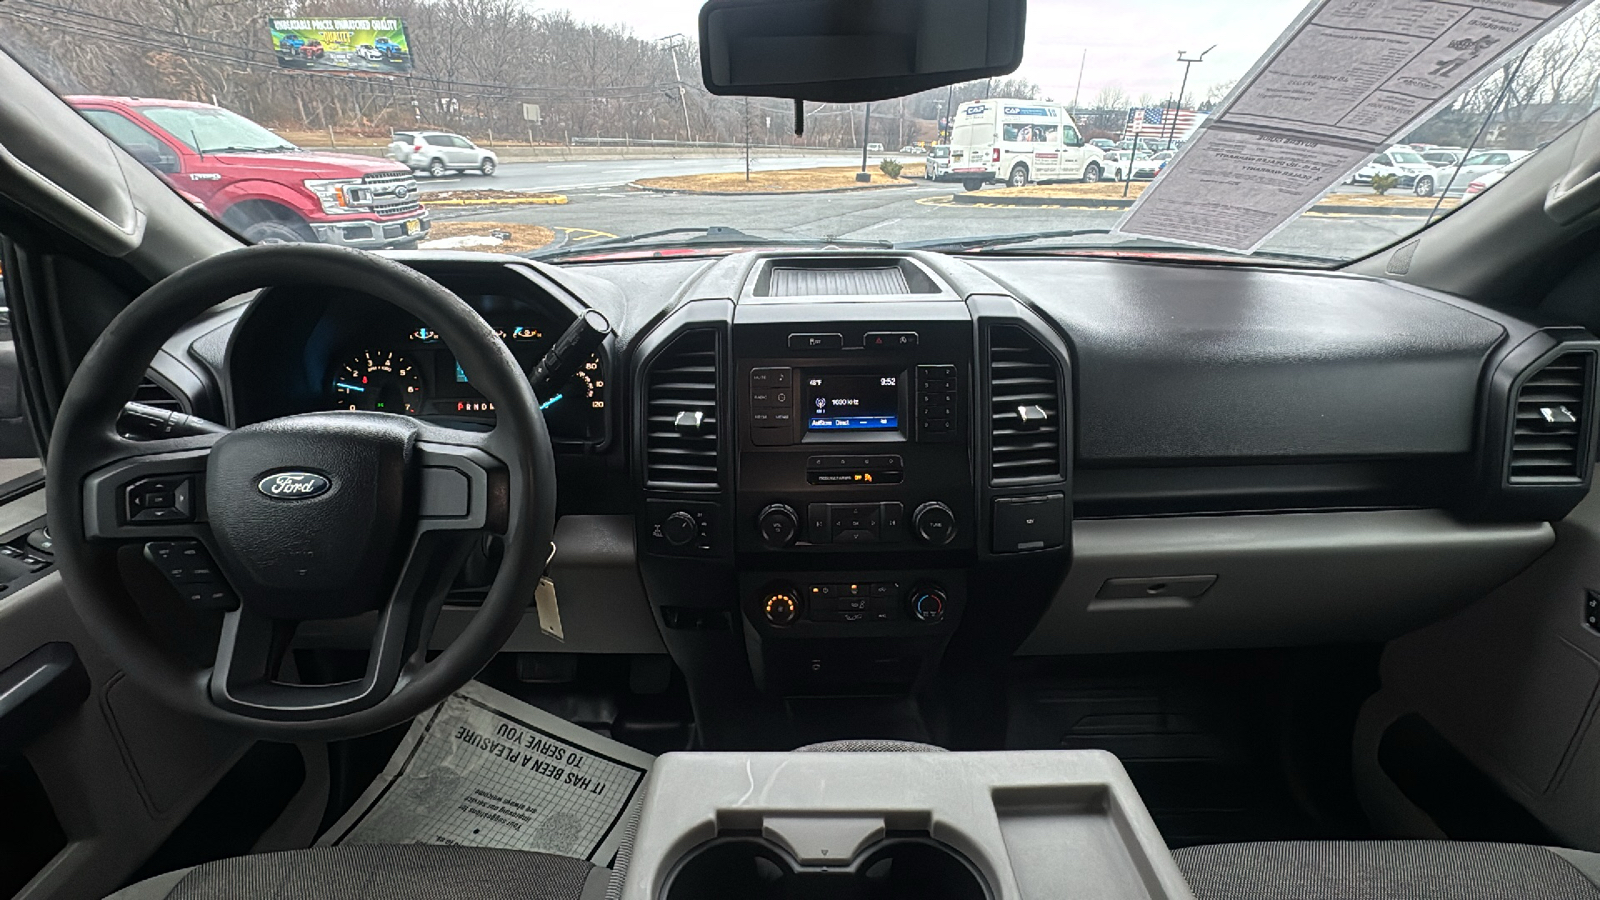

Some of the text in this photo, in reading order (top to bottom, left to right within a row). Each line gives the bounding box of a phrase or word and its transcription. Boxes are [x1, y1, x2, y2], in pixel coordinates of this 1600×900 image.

[372, 20, 397, 30] QUALITY
[323, 32, 351, 44] QUALITY
[880, 378, 896, 386] 9:52
[272, 476, 315, 493] Ford
[496, 724, 584, 768] TO SERVE YOU
[454, 726, 606, 795] IT HAS BEEN A PLEASURE
[464, 796, 487, 809] service
[503, 799, 525, 811] always
[498, 807, 531, 823] improving
[527, 806, 537, 814] are
[468, 808, 506, 825] suggestions
[507, 821, 522, 831] Your
